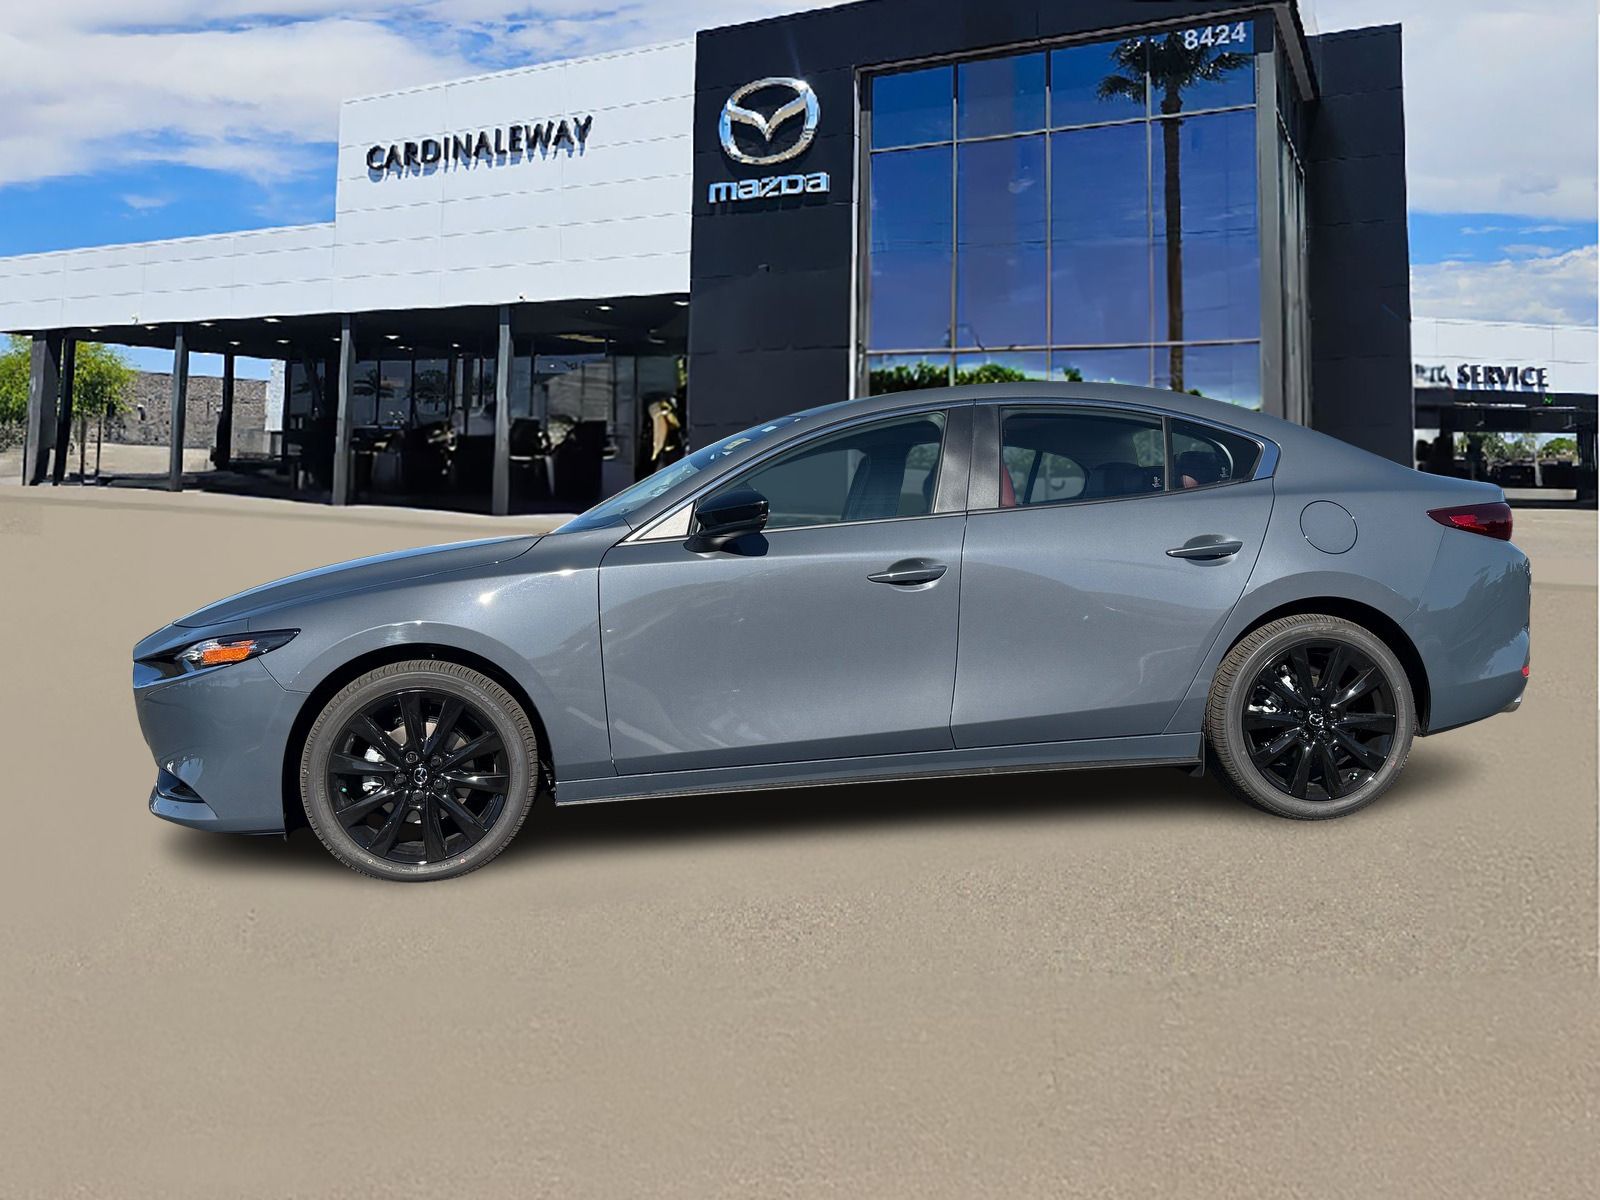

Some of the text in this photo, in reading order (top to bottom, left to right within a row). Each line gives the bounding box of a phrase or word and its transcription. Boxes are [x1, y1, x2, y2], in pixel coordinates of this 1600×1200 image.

[1184, 22, 1246, 50] 8424
[366, 114, 593, 170] CARDINALEWAY
[708, 171, 830, 203] mazda
[1457, 363, 1549, 387] SERVICE
